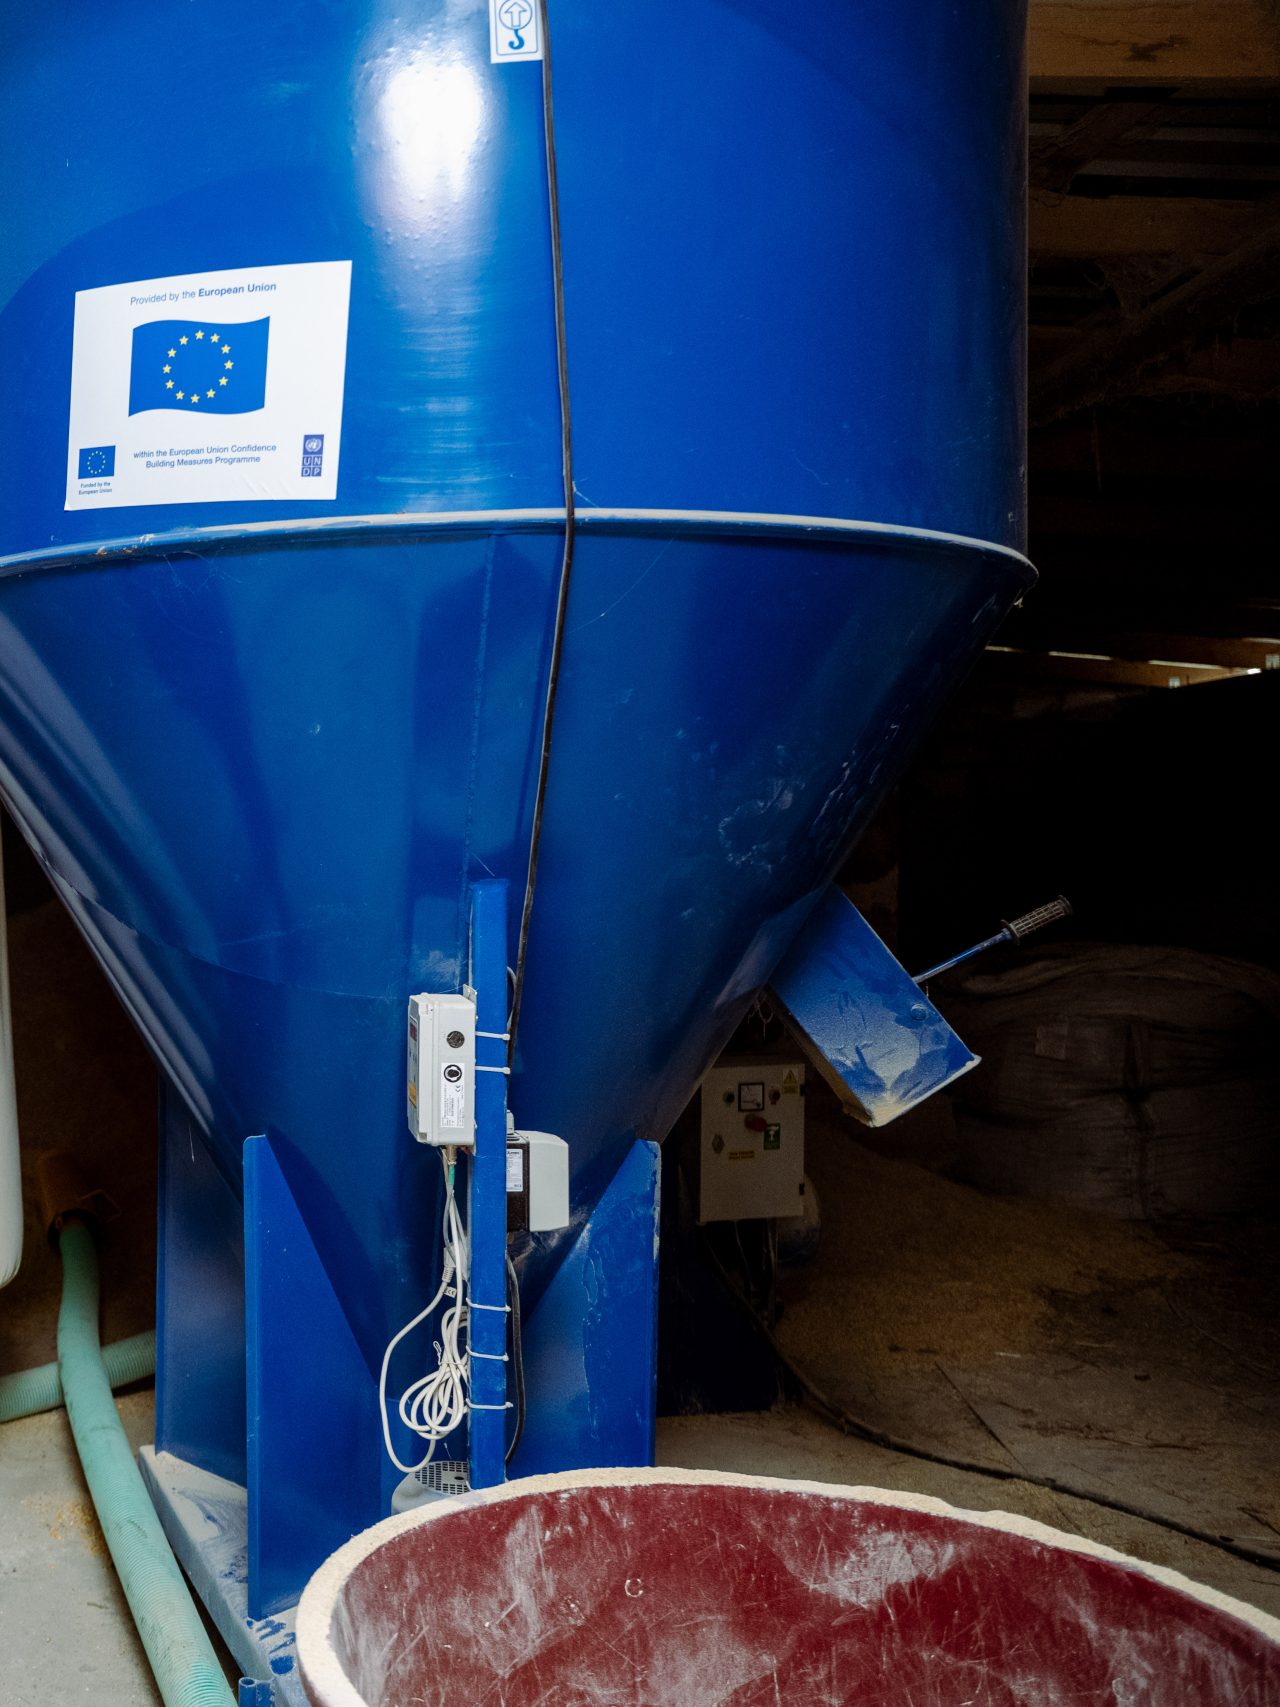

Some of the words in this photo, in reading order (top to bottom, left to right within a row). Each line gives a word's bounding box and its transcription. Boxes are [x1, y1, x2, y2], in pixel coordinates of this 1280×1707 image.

[130, 293, 167, 306] Provided
[169, 292, 179, 303] by
[182, 290, 196, 299] the
[198, 285, 245, 298] European
[247, 283, 277, 293] Union
[133, 449, 154, 459] within
[156, 448, 167, 457] the
[169, 448, 204, 457] European
[206, 445, 229, 454] Union
[231, 444, 277, 453] Confidence
[145, 460, 175, 468] Building
[177, 458, 213, 466] Measures
[215, 456, 261, 465] Programme
